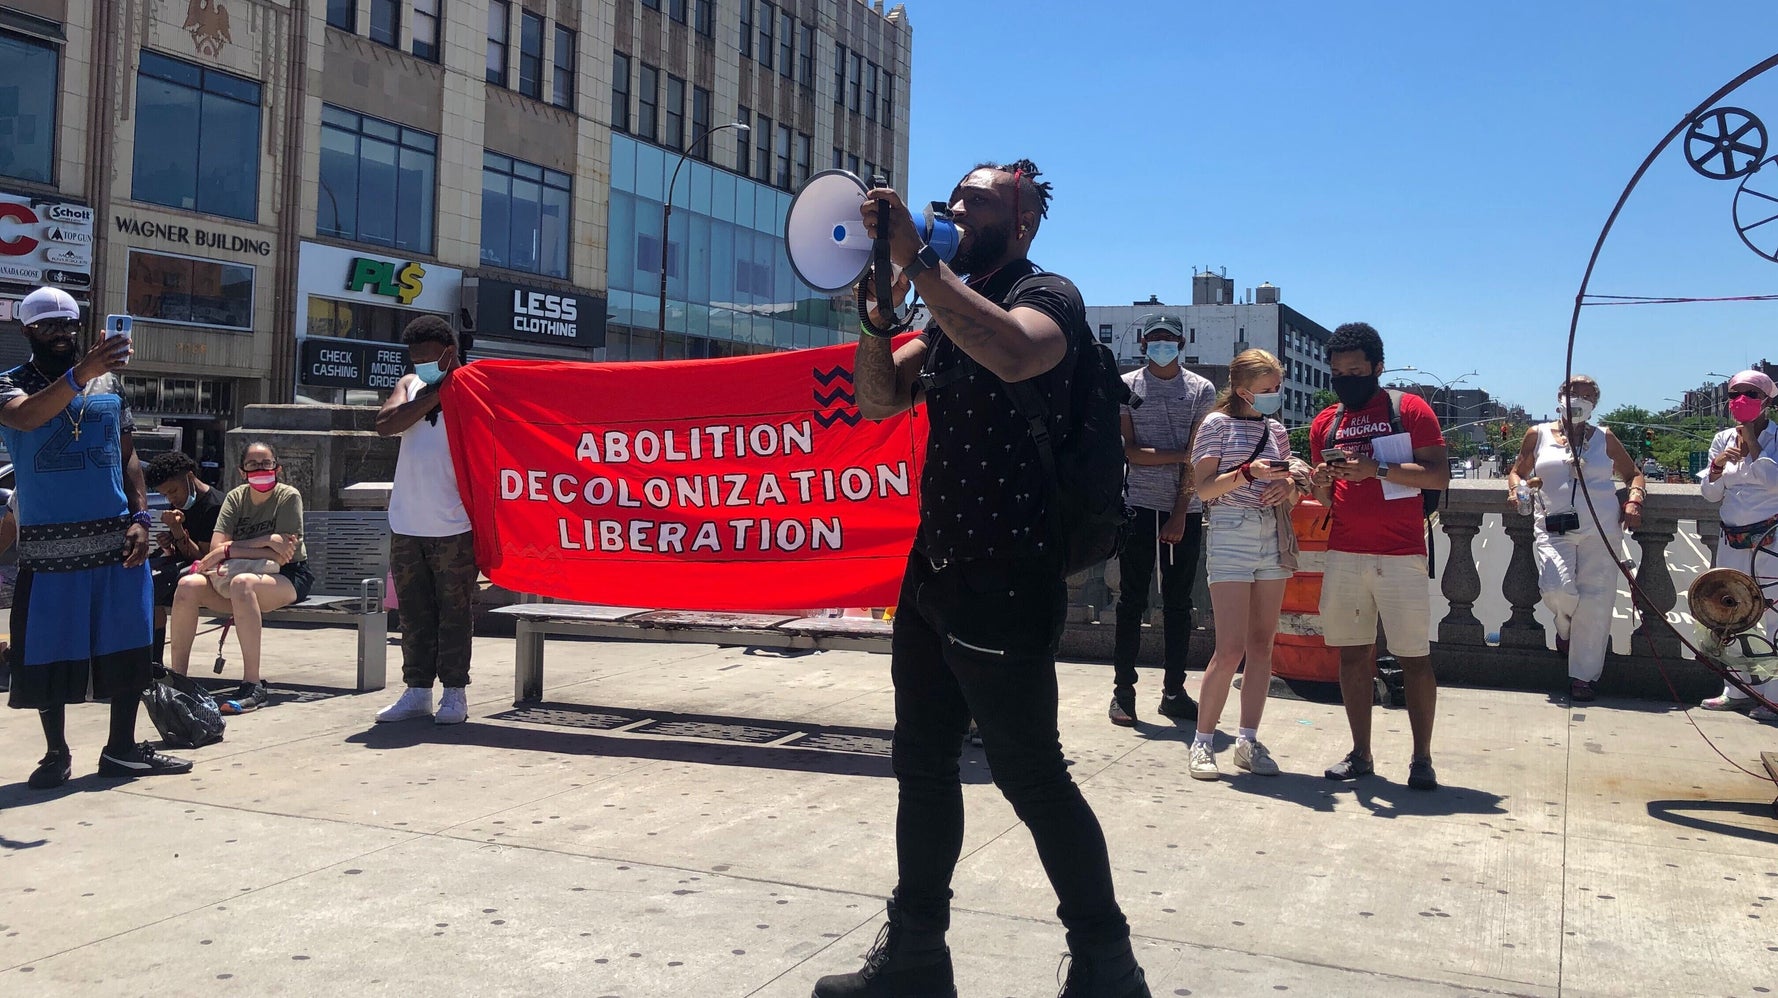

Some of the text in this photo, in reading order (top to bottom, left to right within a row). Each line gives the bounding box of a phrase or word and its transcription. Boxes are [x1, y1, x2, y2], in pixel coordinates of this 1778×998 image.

[53, 206, 90, 220] Schott
[64, 231, 91, 242] TOP GUN
[115, 216, 270, 256] WAGNER BUILDING
[0, 266, 19, 276] ANADA
[513, 289, 577, 321] LESS
[513, 316, 577, 337] CLOTHING
[320, 349, 352, 364] CHECK
[377, 350, 402, 363] FREE
[312, 363, 358, 378] CASHING
[371, 362, 407, 376] MONEY
[1350, 415, 1370, 426] REAL
[1335, 422, 1392, 440] EMOCRACY
[575, 420, 813, 464] ABOLITION
[500, 461, 911, 508] DECOLONIZATION
[557, 516, 843, 553] LIBERATION
